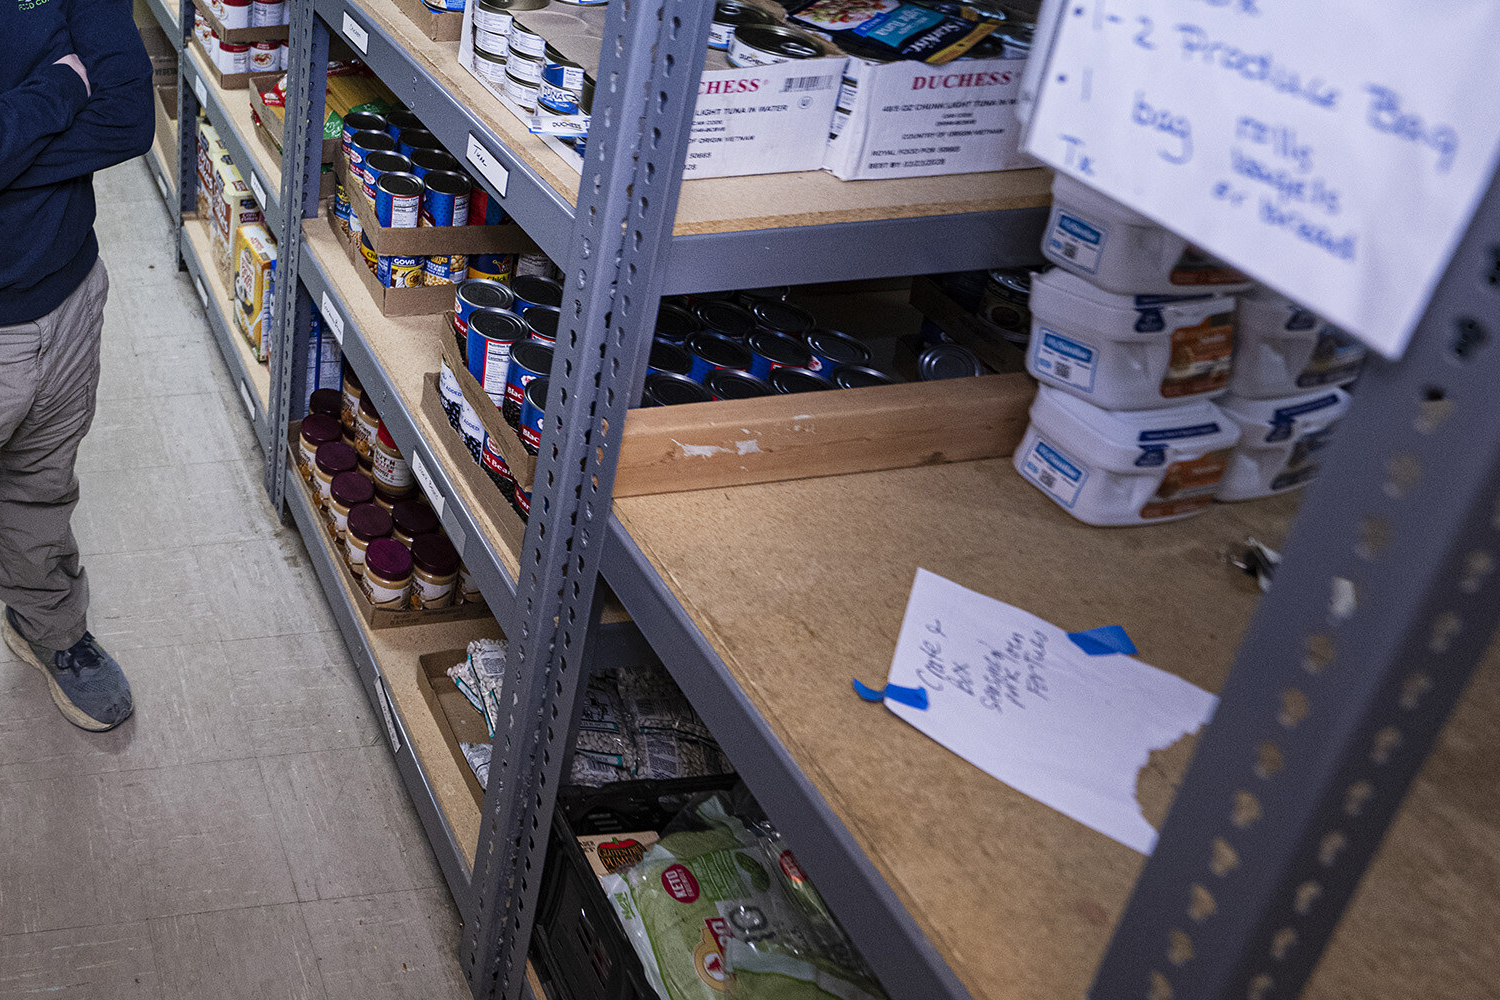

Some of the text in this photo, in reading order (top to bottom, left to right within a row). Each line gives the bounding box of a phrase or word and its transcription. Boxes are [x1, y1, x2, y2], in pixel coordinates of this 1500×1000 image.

[697, 78, 761, 95] CHESS
[911, 70, 1012, 91] DUCHESS
[542, 88, 563, 102] TUNA
[393, 257, 416, 266] GOYA
[507, 385, 523, 399] Blac
[522, 427, 540, 443] Blac
[491, 458, 511, 476] Bean
[664, 869, 688, 899] KETO
